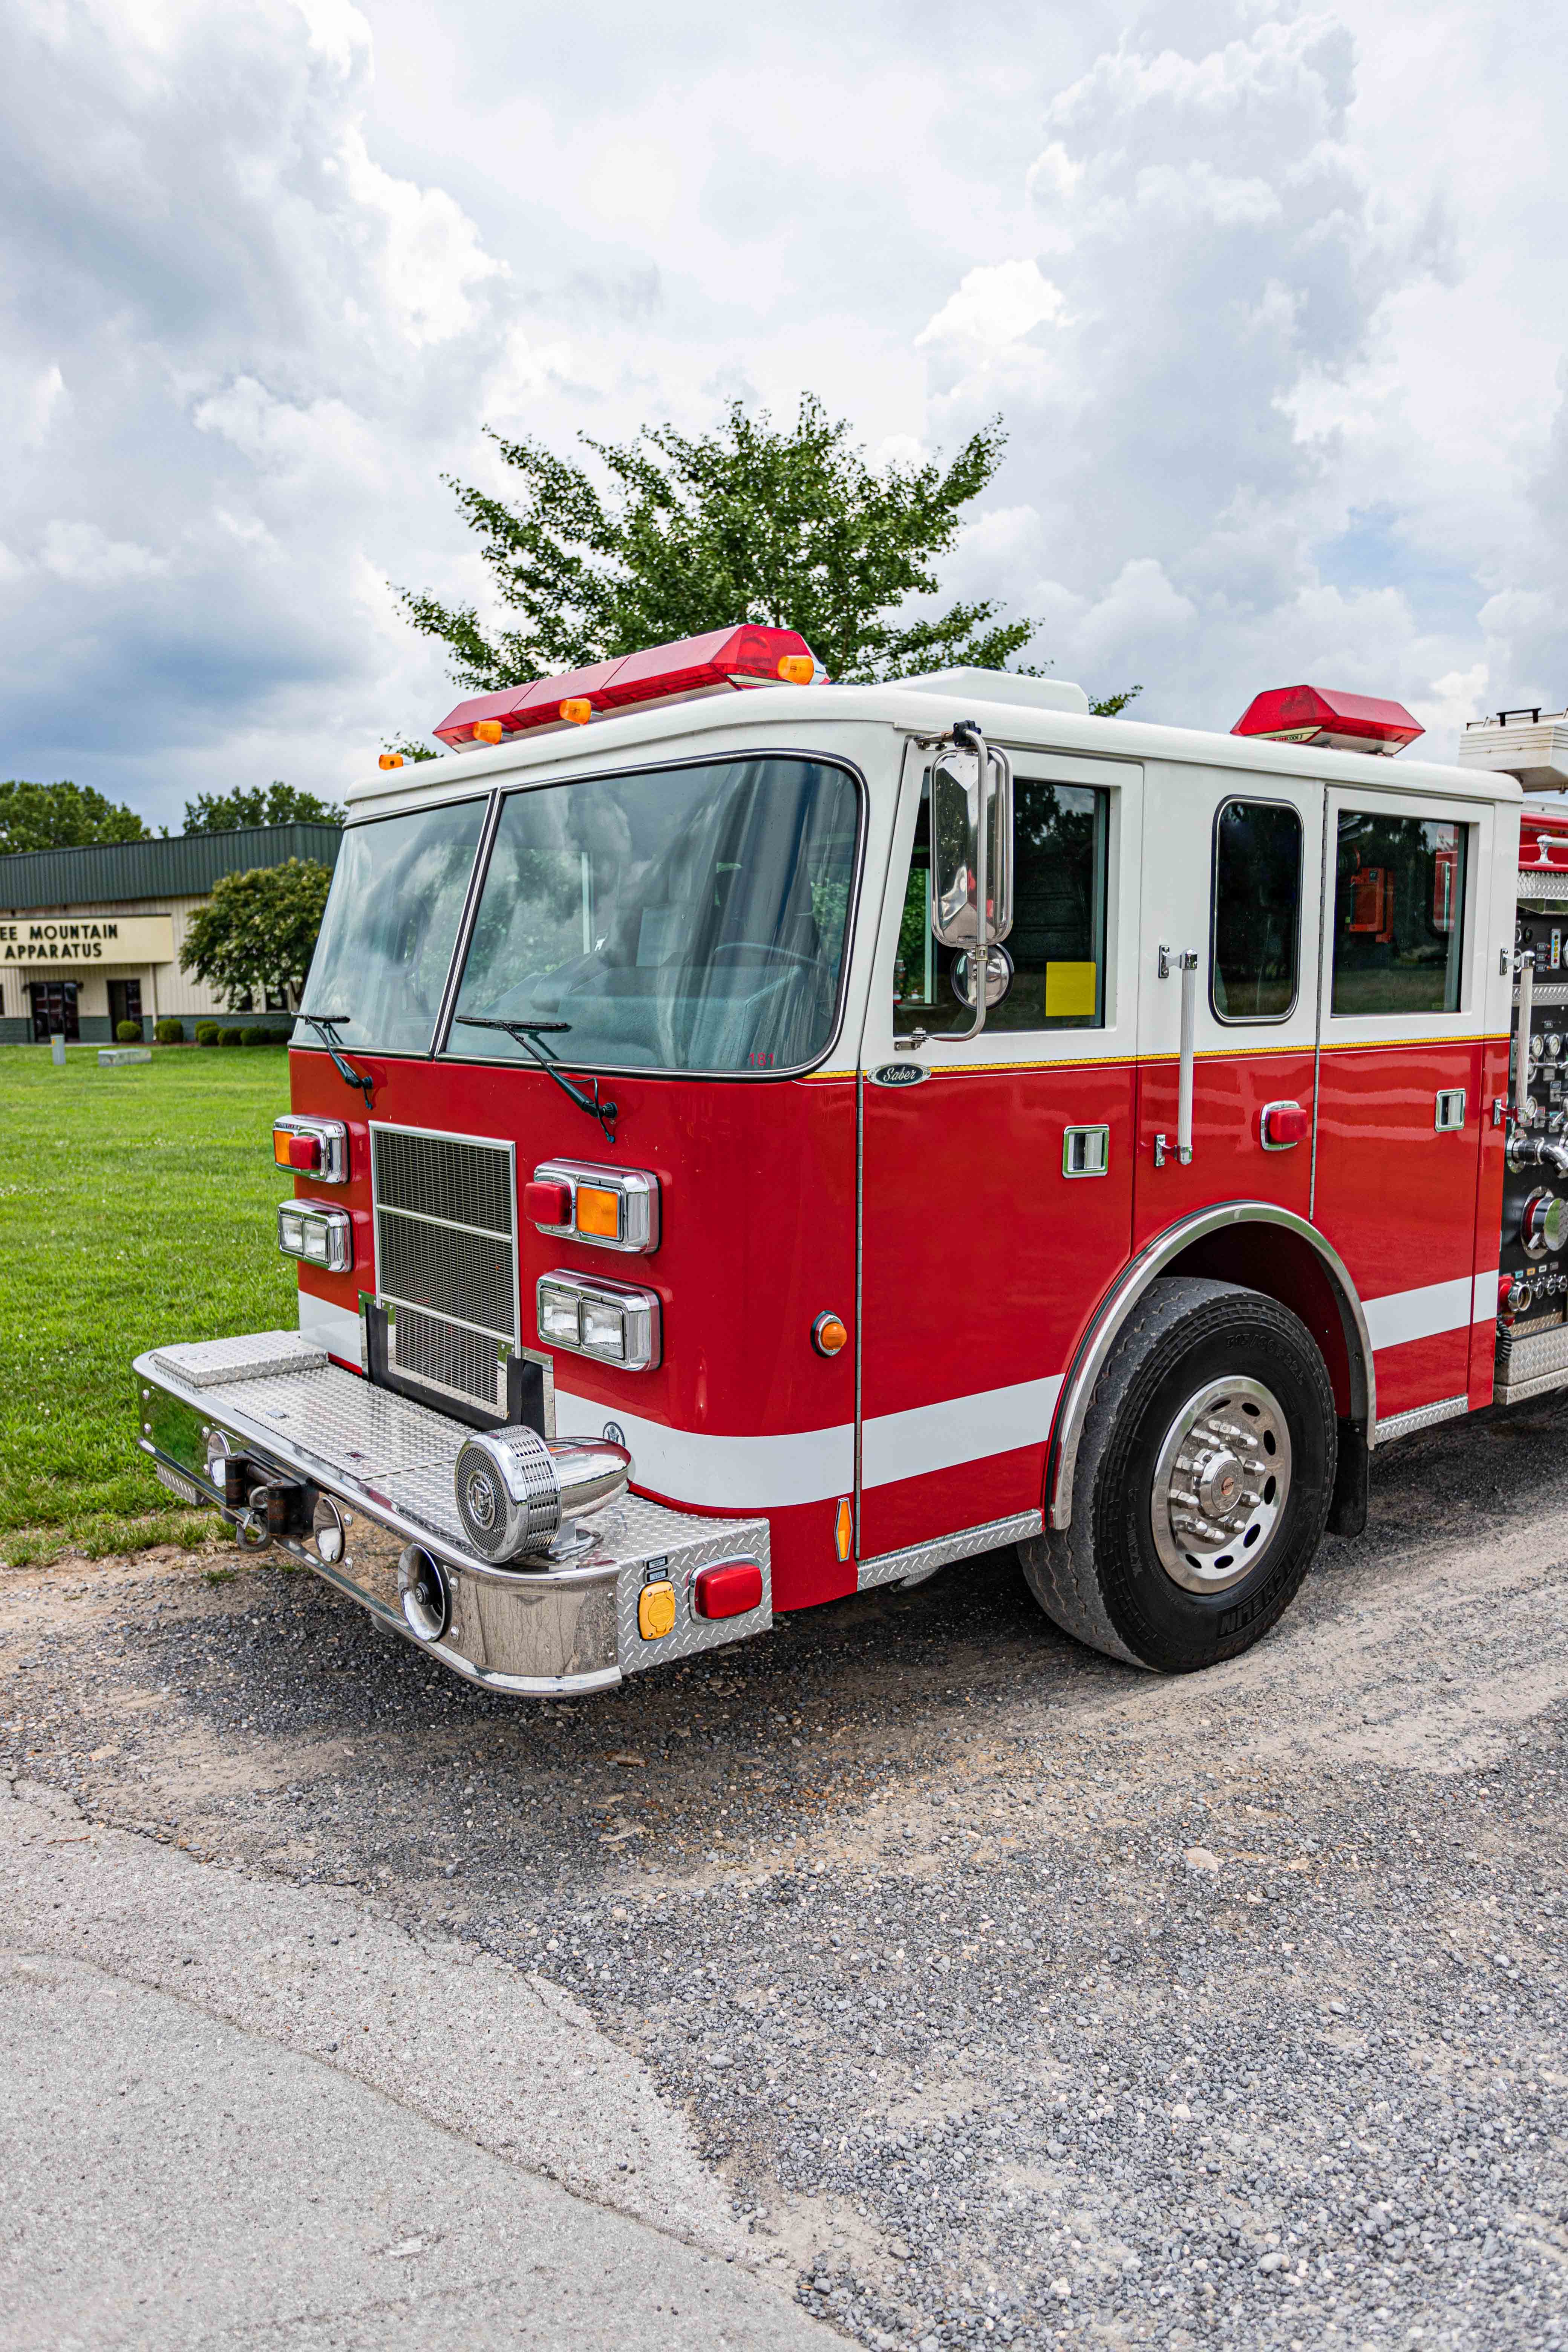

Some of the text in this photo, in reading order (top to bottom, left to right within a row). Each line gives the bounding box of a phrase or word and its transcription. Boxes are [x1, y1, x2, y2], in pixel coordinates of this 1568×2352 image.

[30, 924, 118, 940] MOUNTAIN
[5, 943, 102, 960] APPARATUS
[749, 1052, 774, 1067] 181
[883, 1067, 916, 1082] Saber
